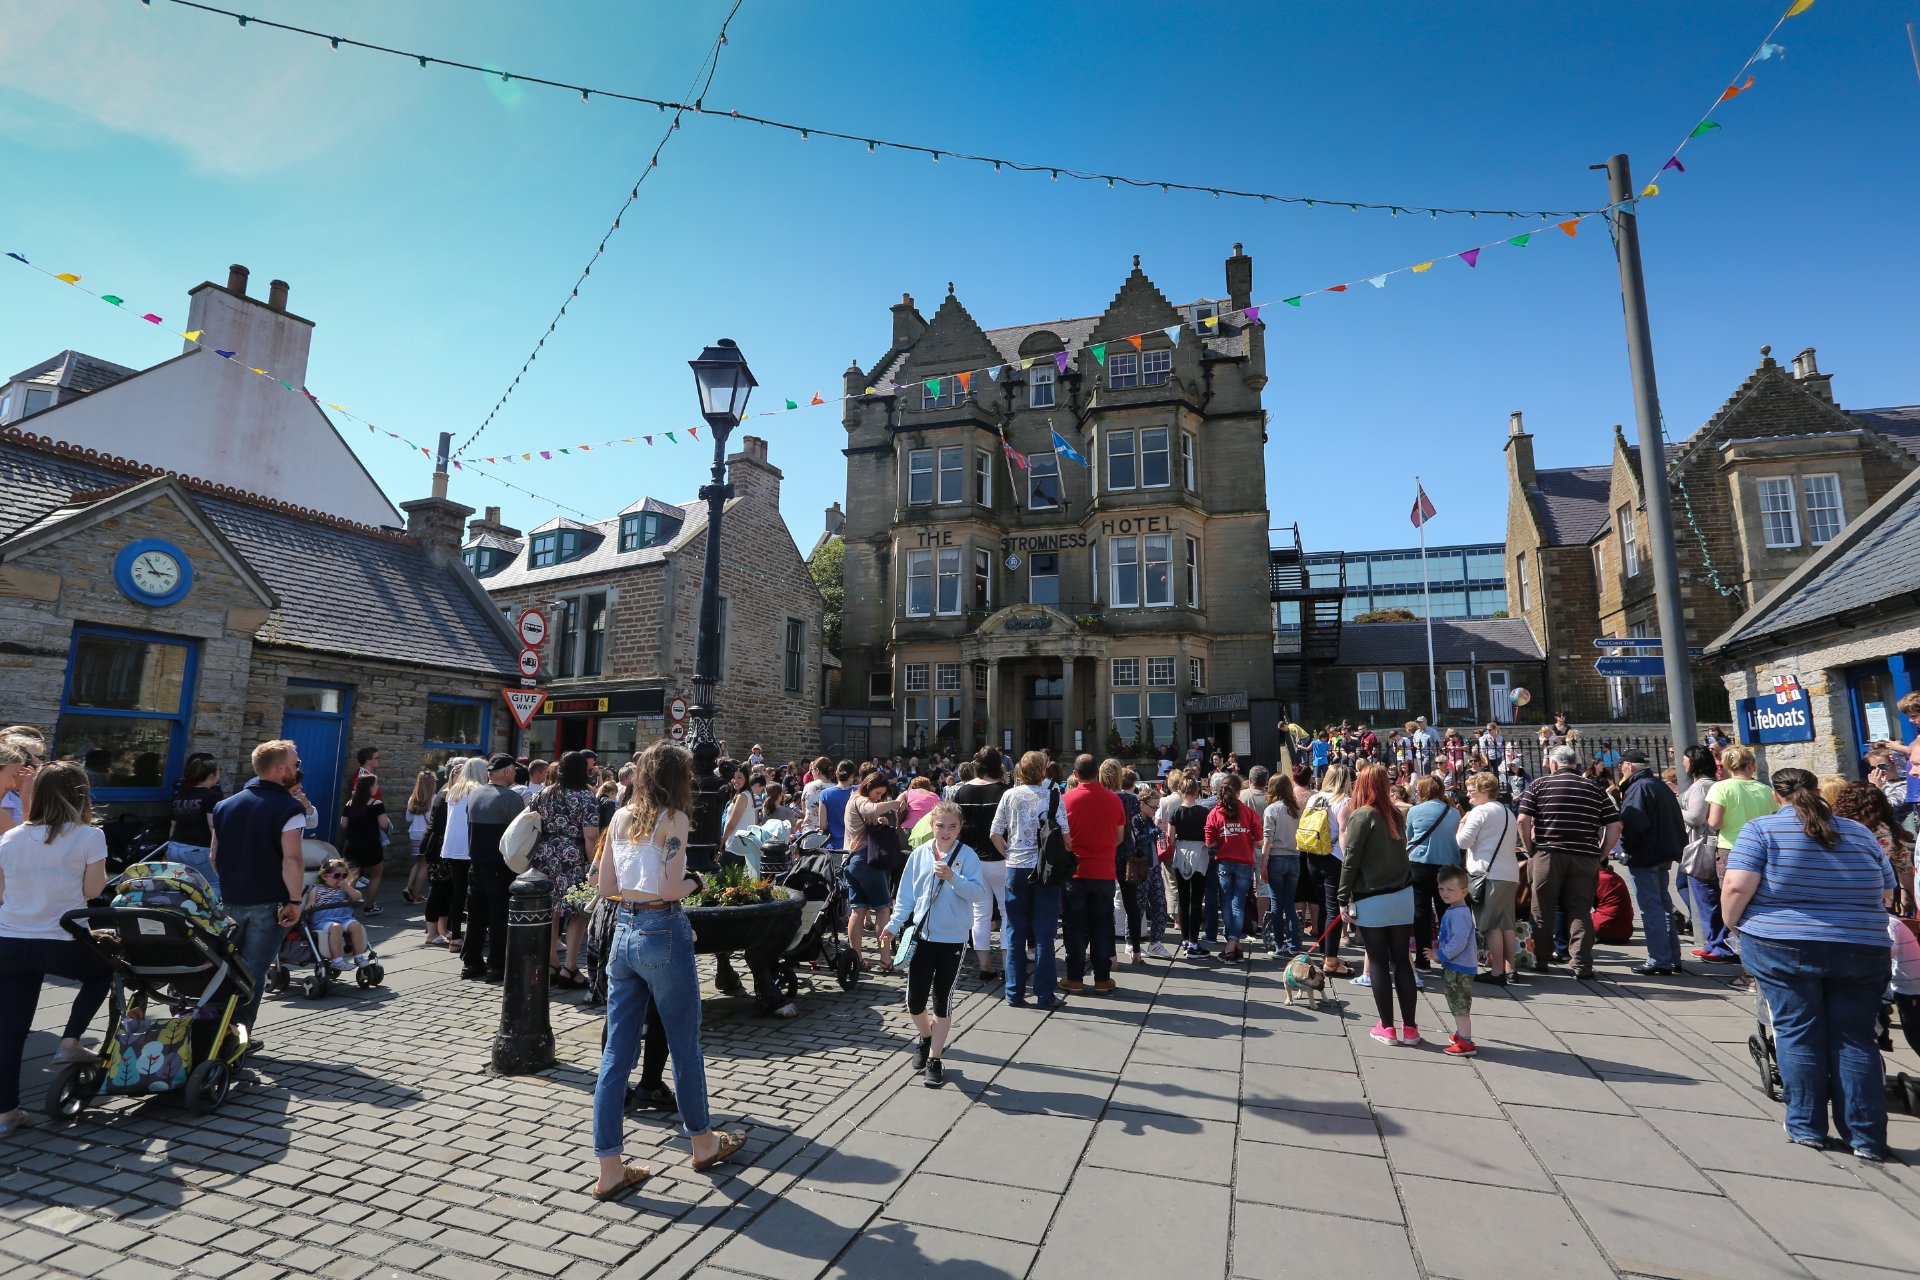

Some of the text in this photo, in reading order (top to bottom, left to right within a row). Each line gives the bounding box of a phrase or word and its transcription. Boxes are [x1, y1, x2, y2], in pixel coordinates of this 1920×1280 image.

[917, 516, 1177, 551] THE STROMNESS HOTEL
[511, 694, 538, 703] GIVE
[1747, 708, 1806, 731] Lifeboats
